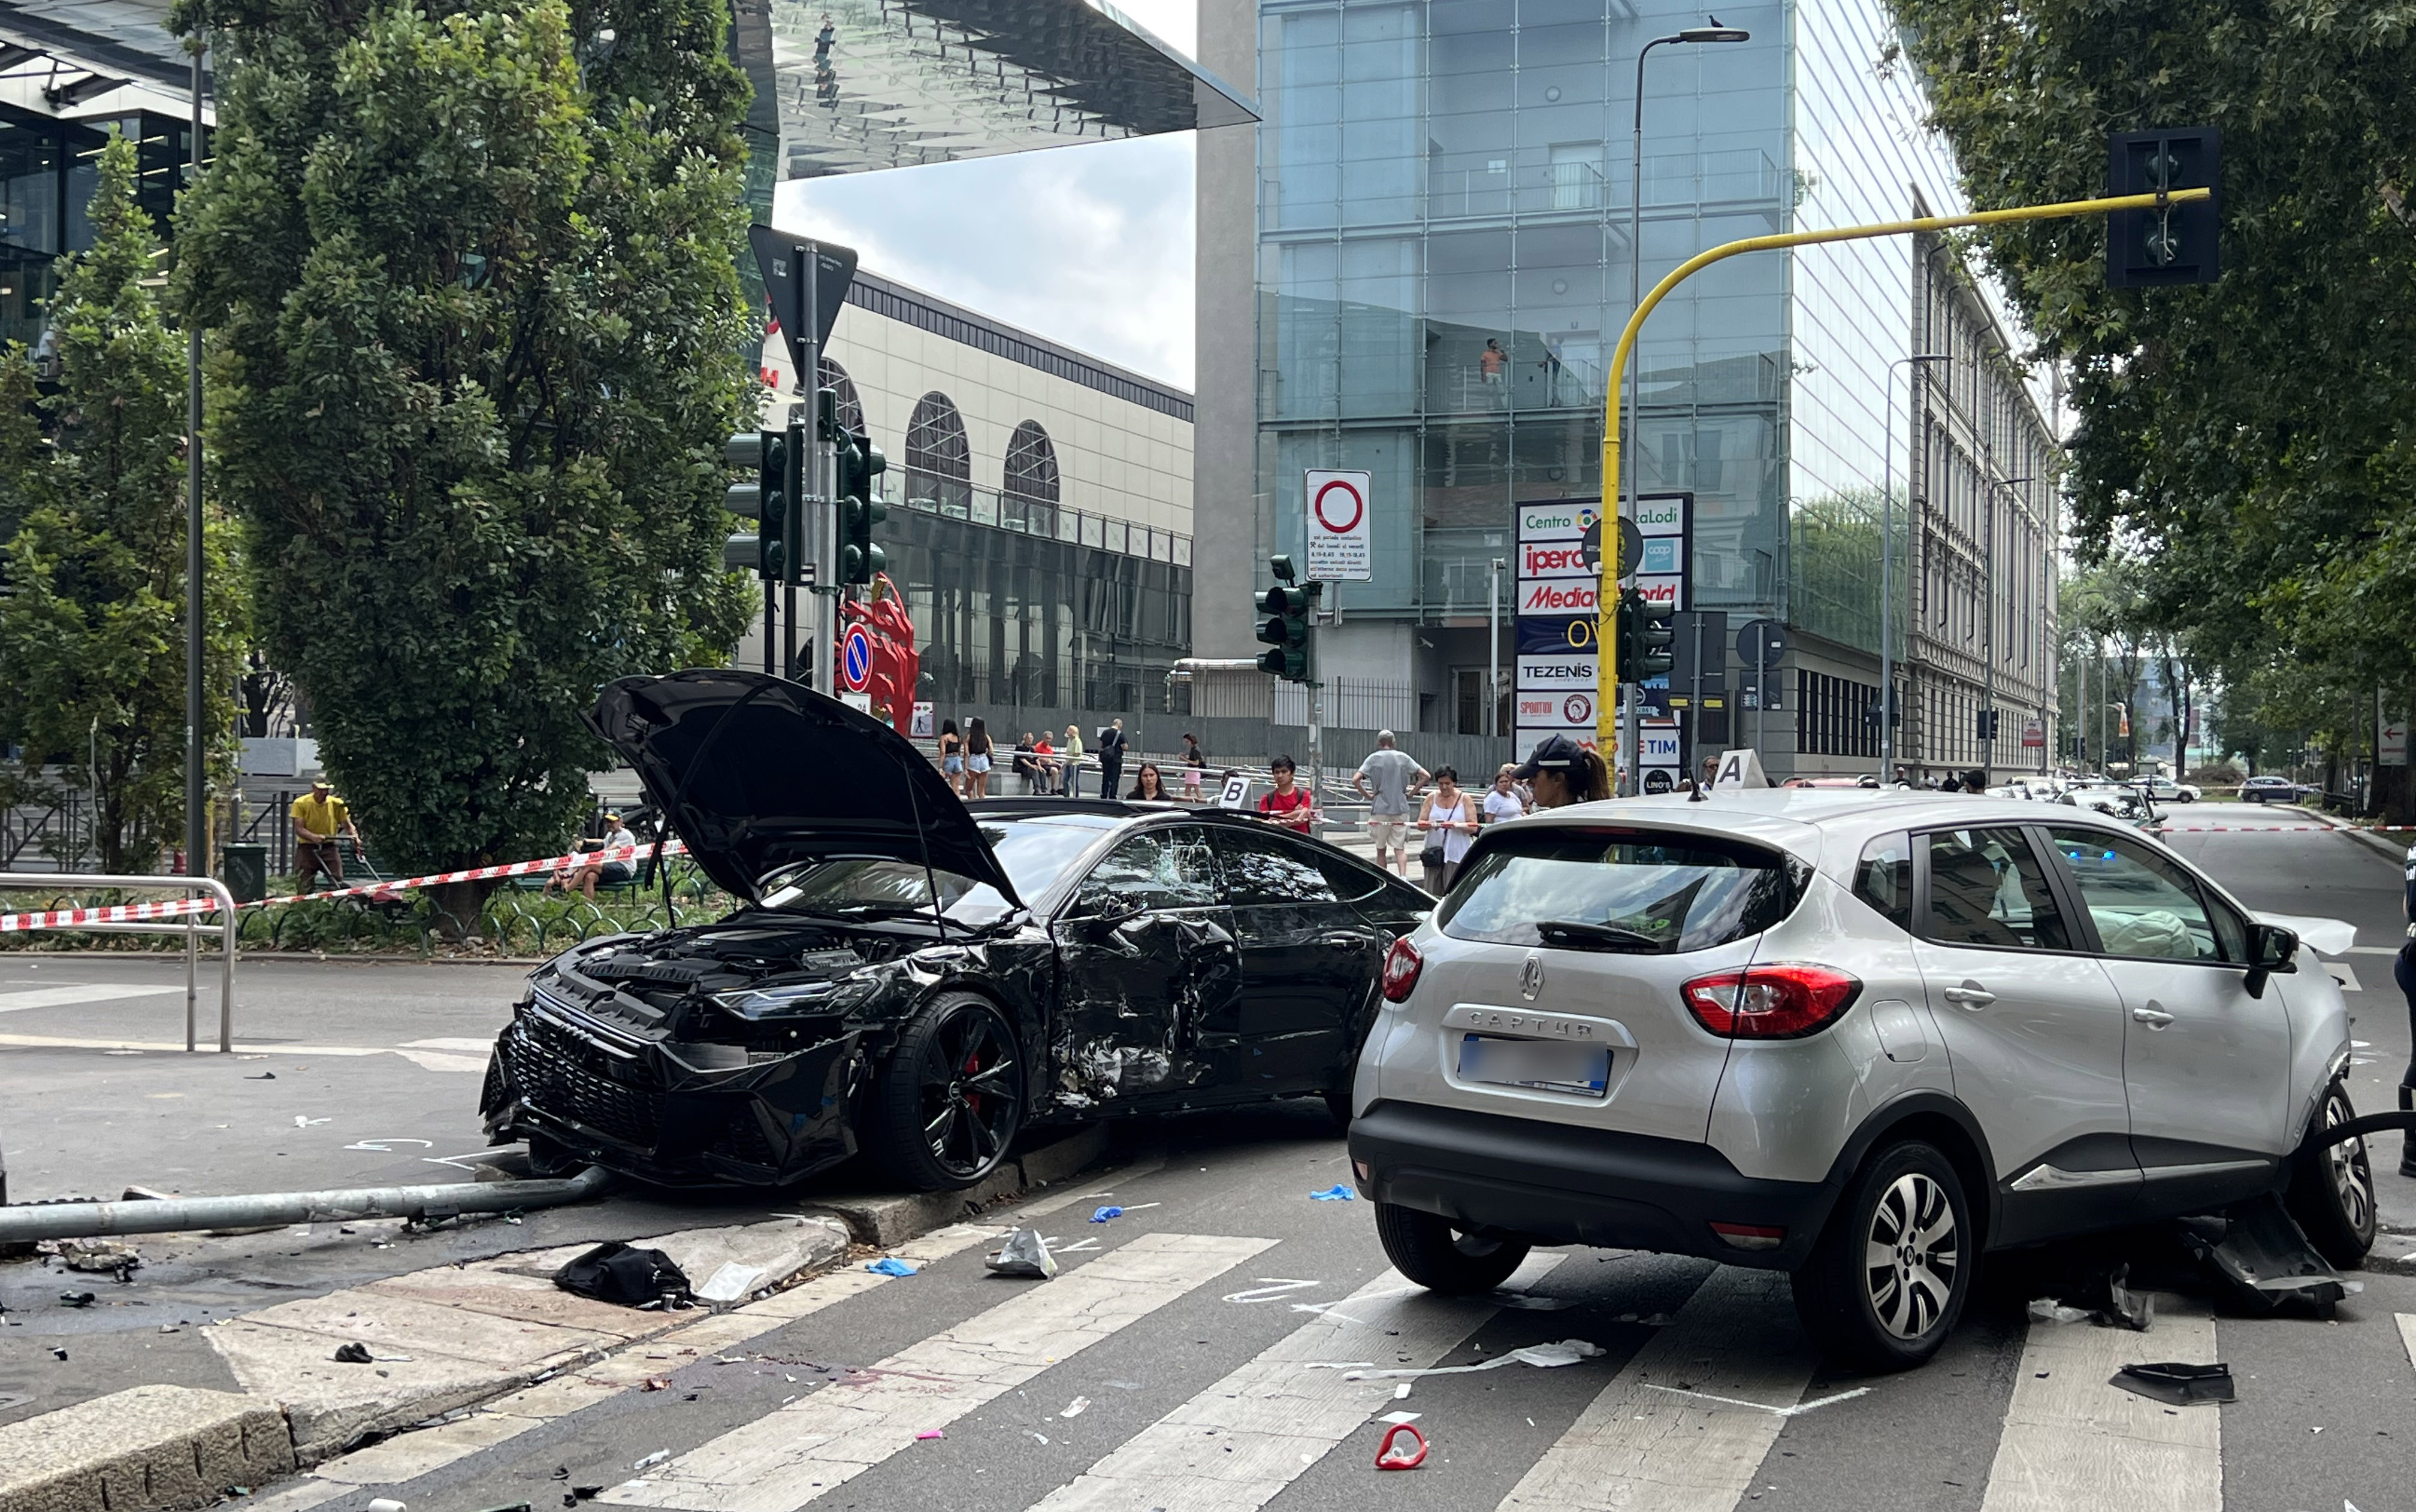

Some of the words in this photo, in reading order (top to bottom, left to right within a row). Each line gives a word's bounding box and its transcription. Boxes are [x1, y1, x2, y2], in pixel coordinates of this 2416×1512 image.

[1526, 515, 1571, 529] Centro
[1636, 507, 1678, 524] aLodi
[1648, 740, 1676, 754] TIM
[1717, 755, 1740, 783] A
[1224, 781, 1244, 802] B
[1469, 1011, 1593, 1038] CAPTUR
